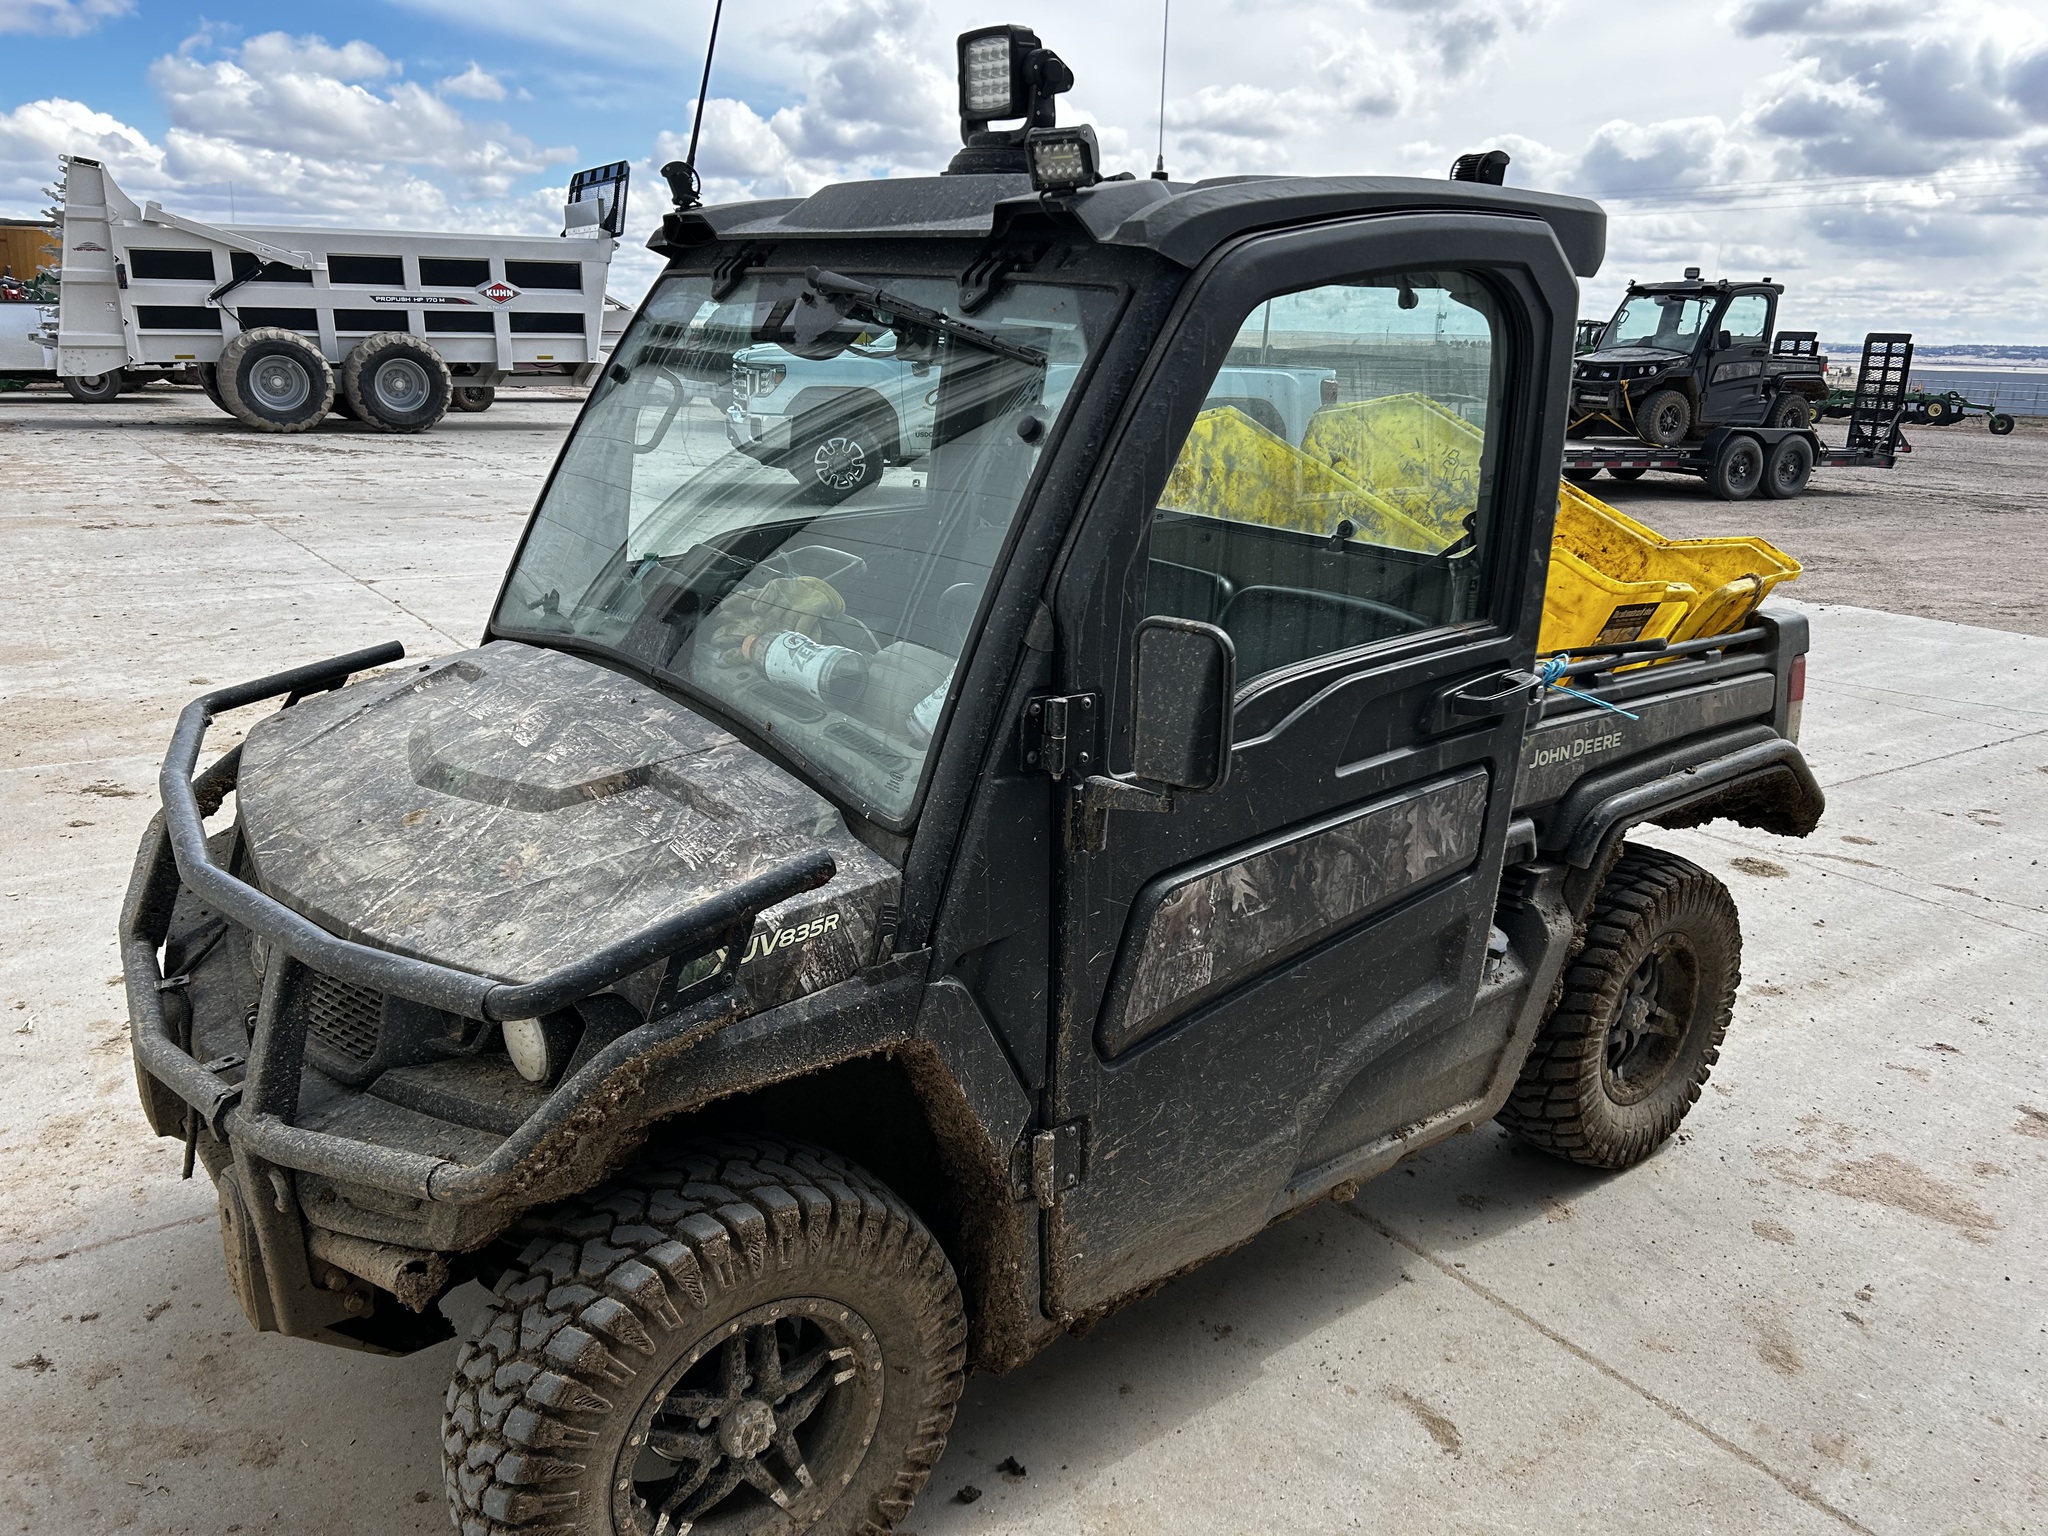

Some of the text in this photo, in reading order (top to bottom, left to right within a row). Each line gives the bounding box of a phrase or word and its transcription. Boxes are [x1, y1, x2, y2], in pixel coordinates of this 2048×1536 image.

[486, 288, 514, 297] KUHN
[1528, 732, 1623, 770] JOHN DEERE
